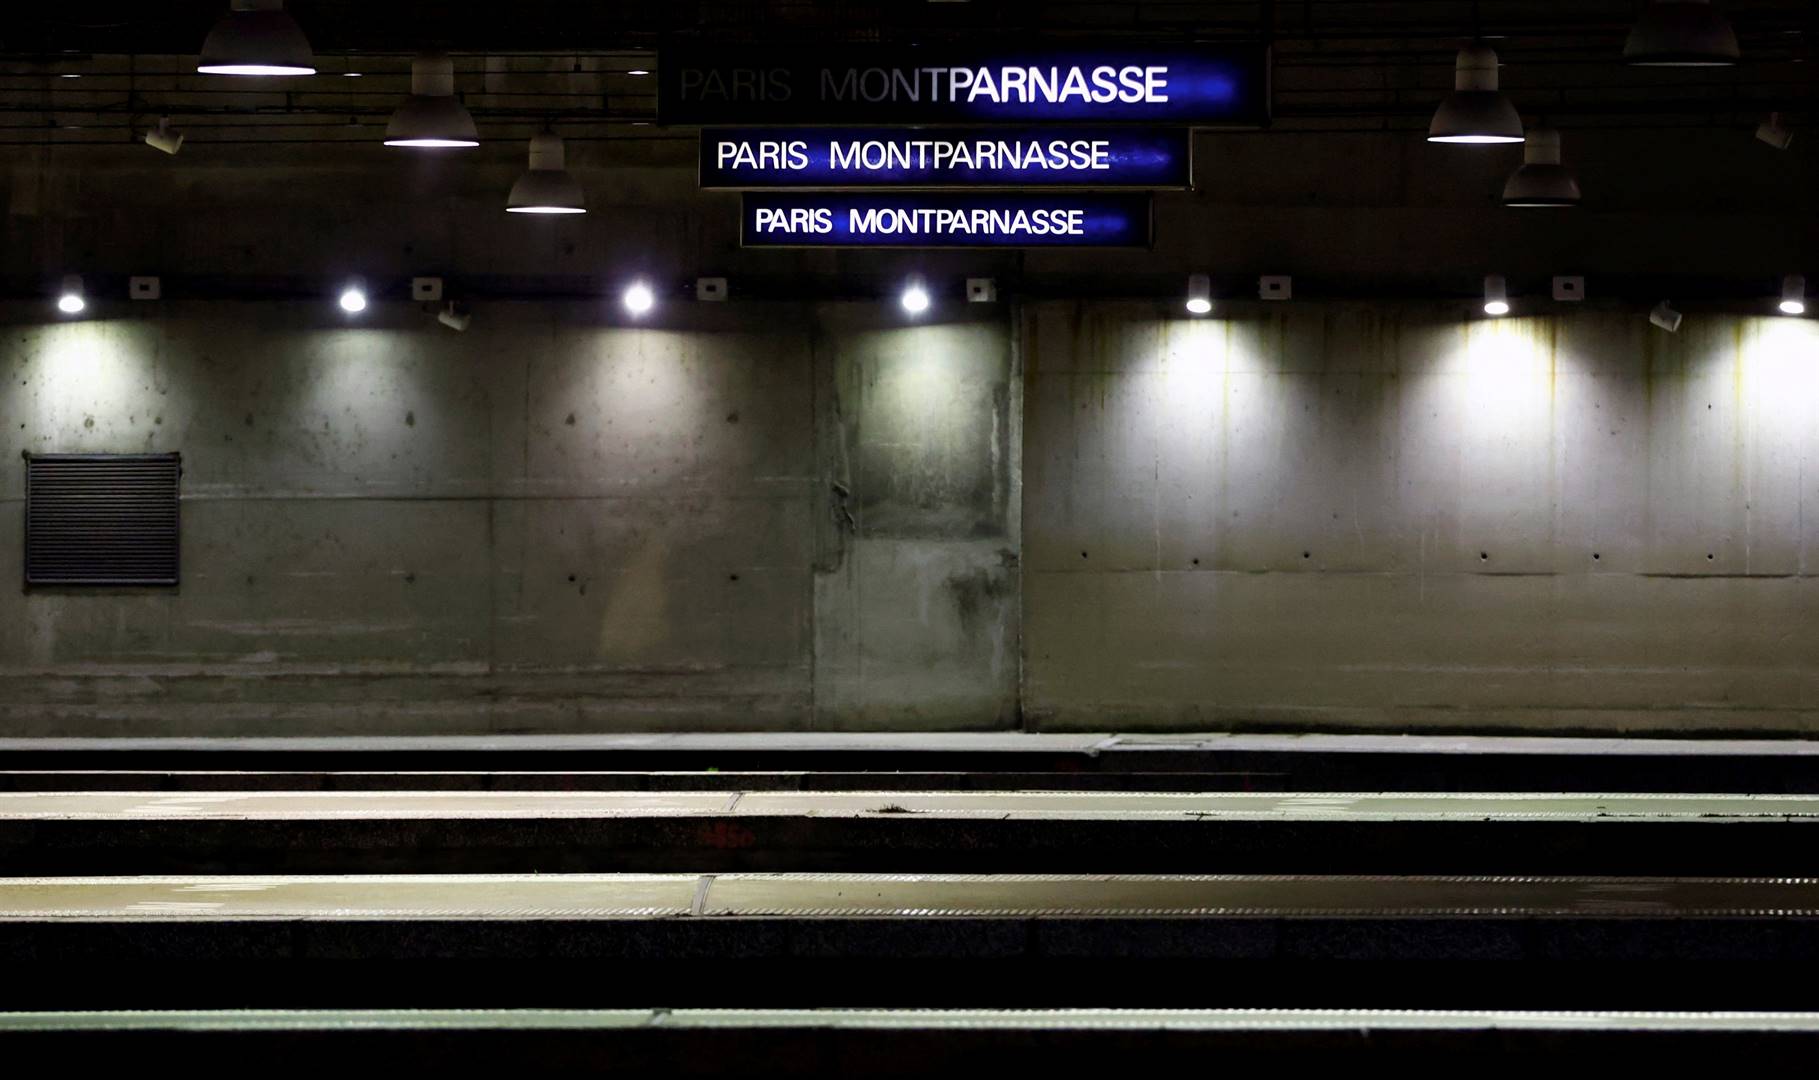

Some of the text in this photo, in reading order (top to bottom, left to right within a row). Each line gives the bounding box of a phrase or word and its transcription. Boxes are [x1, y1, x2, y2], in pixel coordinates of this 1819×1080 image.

[679, 65, 1168, 103] PARIS MONTPARNASSE
[717, 140, 1109, 169] PARIS MONTPARNASSE
[755, 208, 1083, 234] PARIS MONTPARNASSE
